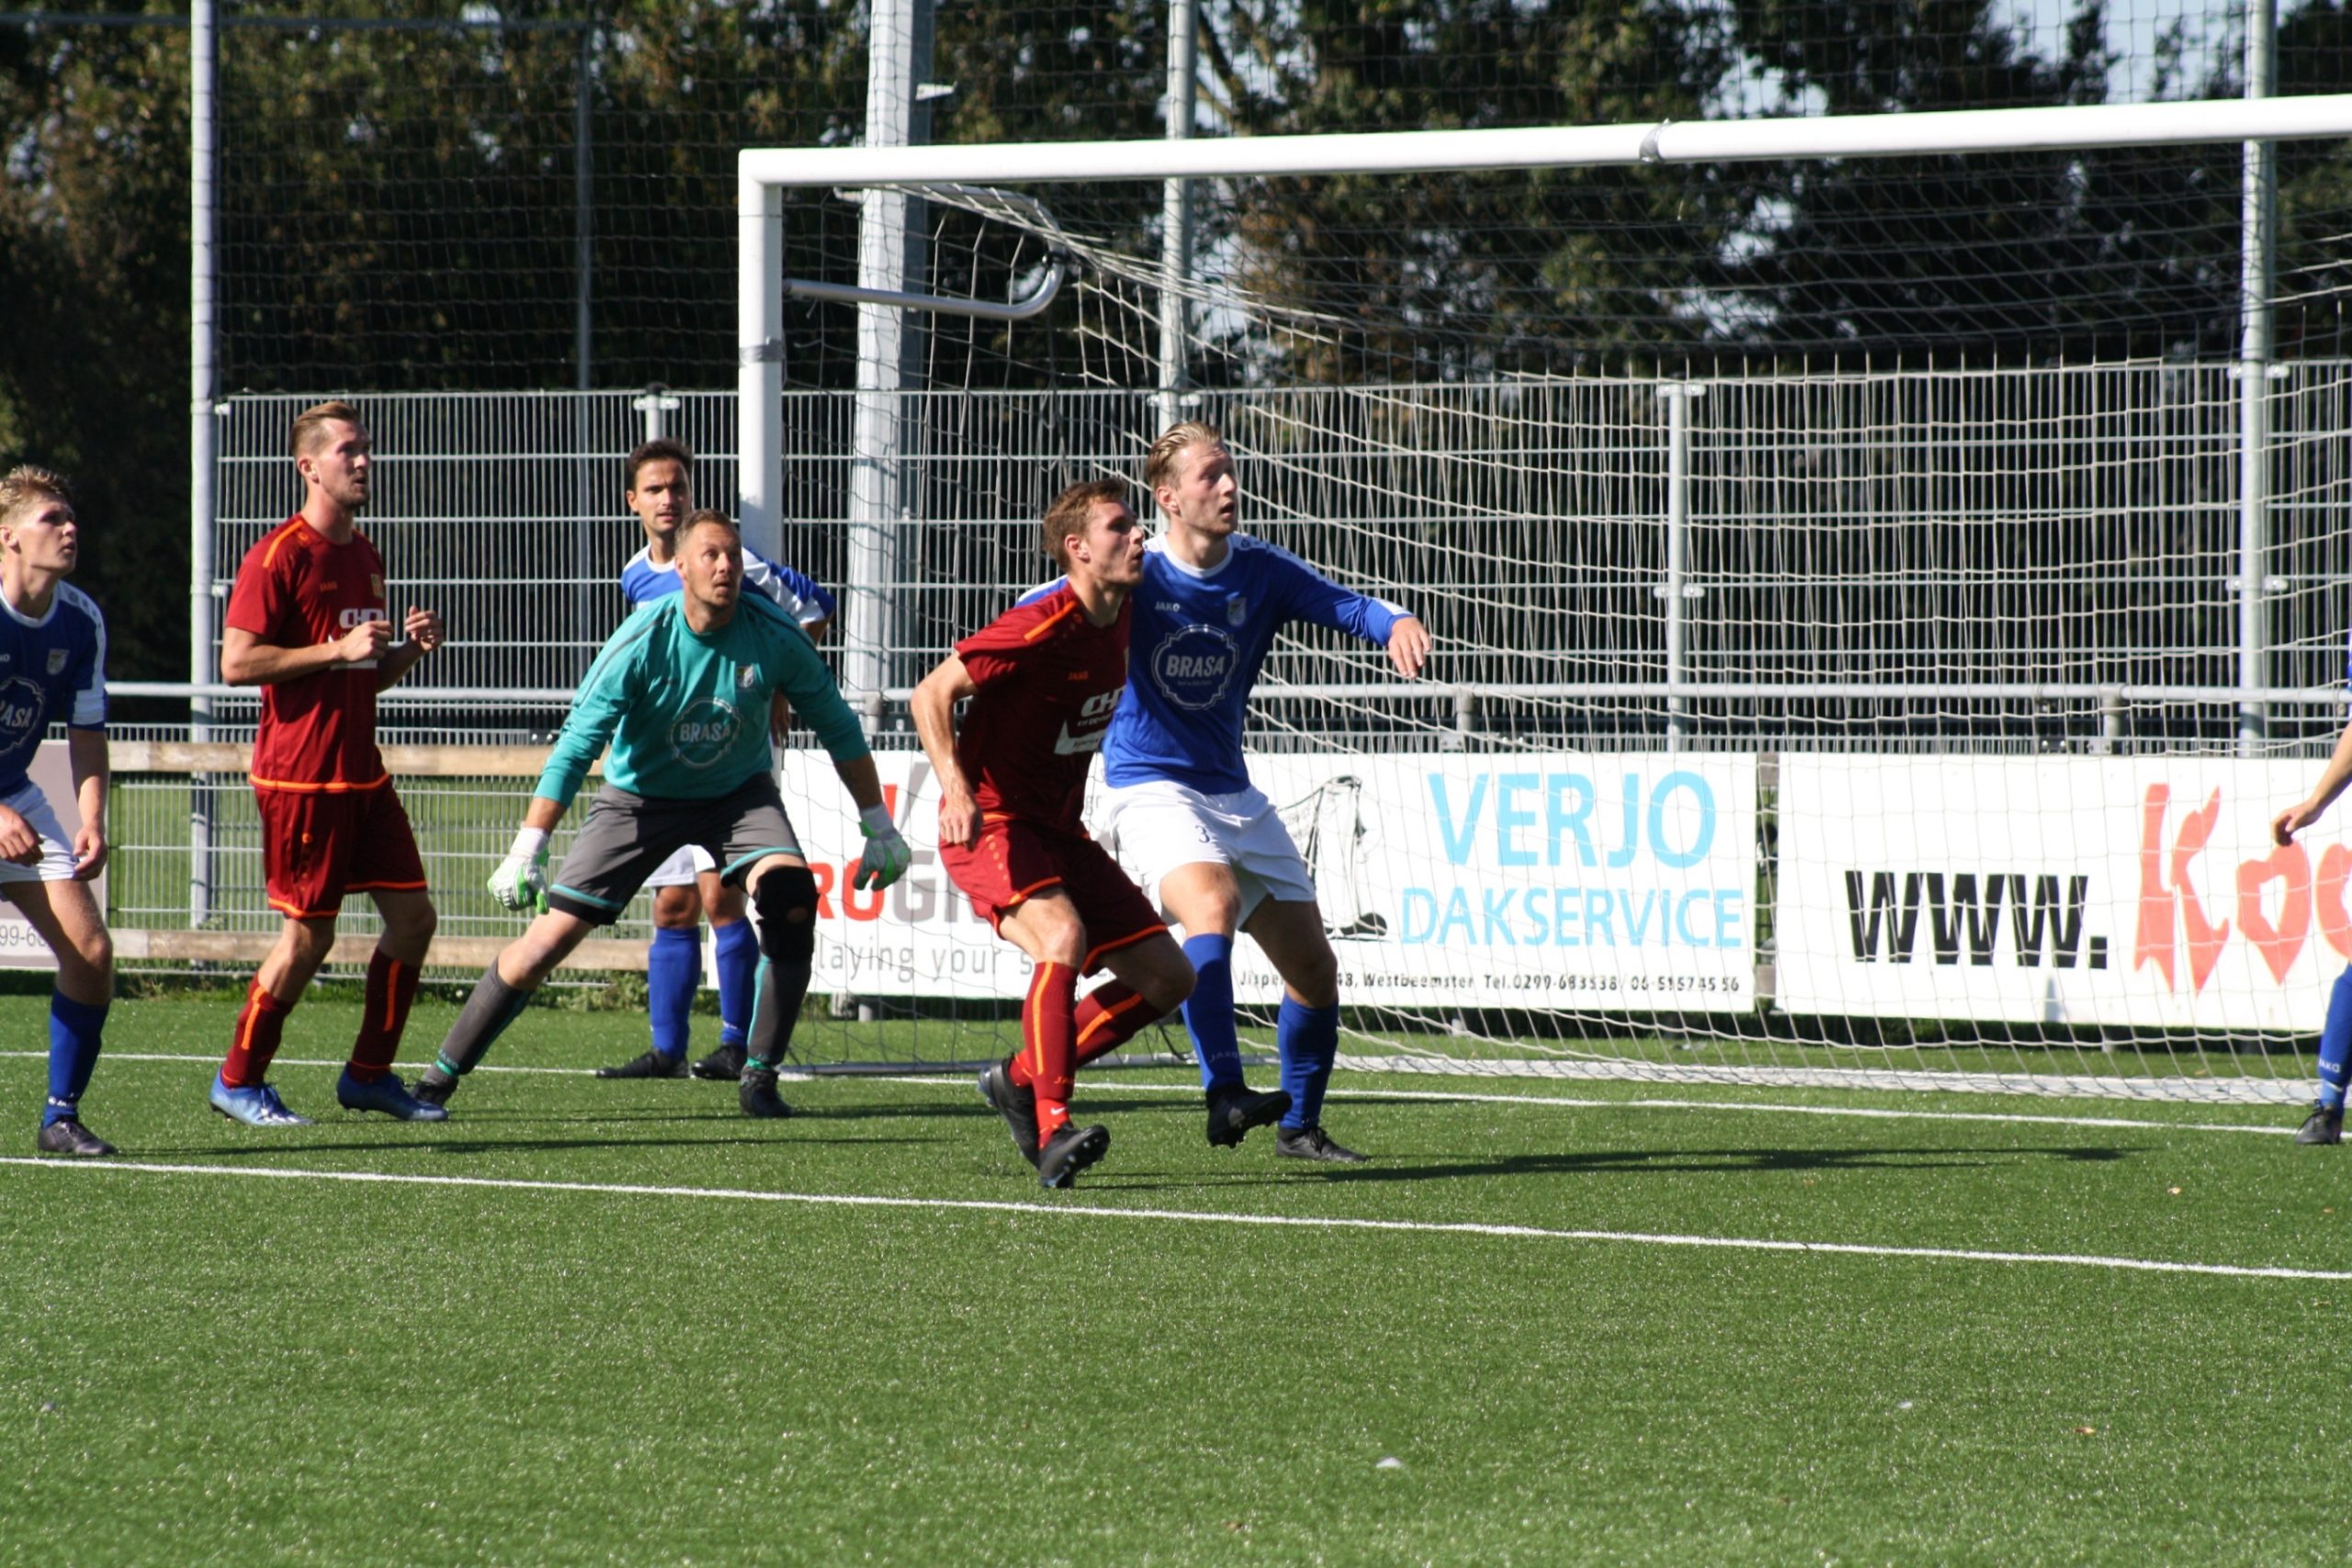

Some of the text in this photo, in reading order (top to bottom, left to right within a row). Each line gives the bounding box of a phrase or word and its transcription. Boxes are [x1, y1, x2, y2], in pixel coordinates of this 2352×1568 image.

[1155, 602, 1181, 613] JAKO
[1165, 655, 1226, 677] BRASA
[680, 722, 731, 742] BRASA
[1428, 771, 1716, 869] VERJO
[1195, 825, 1211, 843] 3
[1400, 886, 1743, 947] DAKSERVICE
[932, 946, 1002, 982] your
[1363, 972, 1474, 989] Westbeemster
